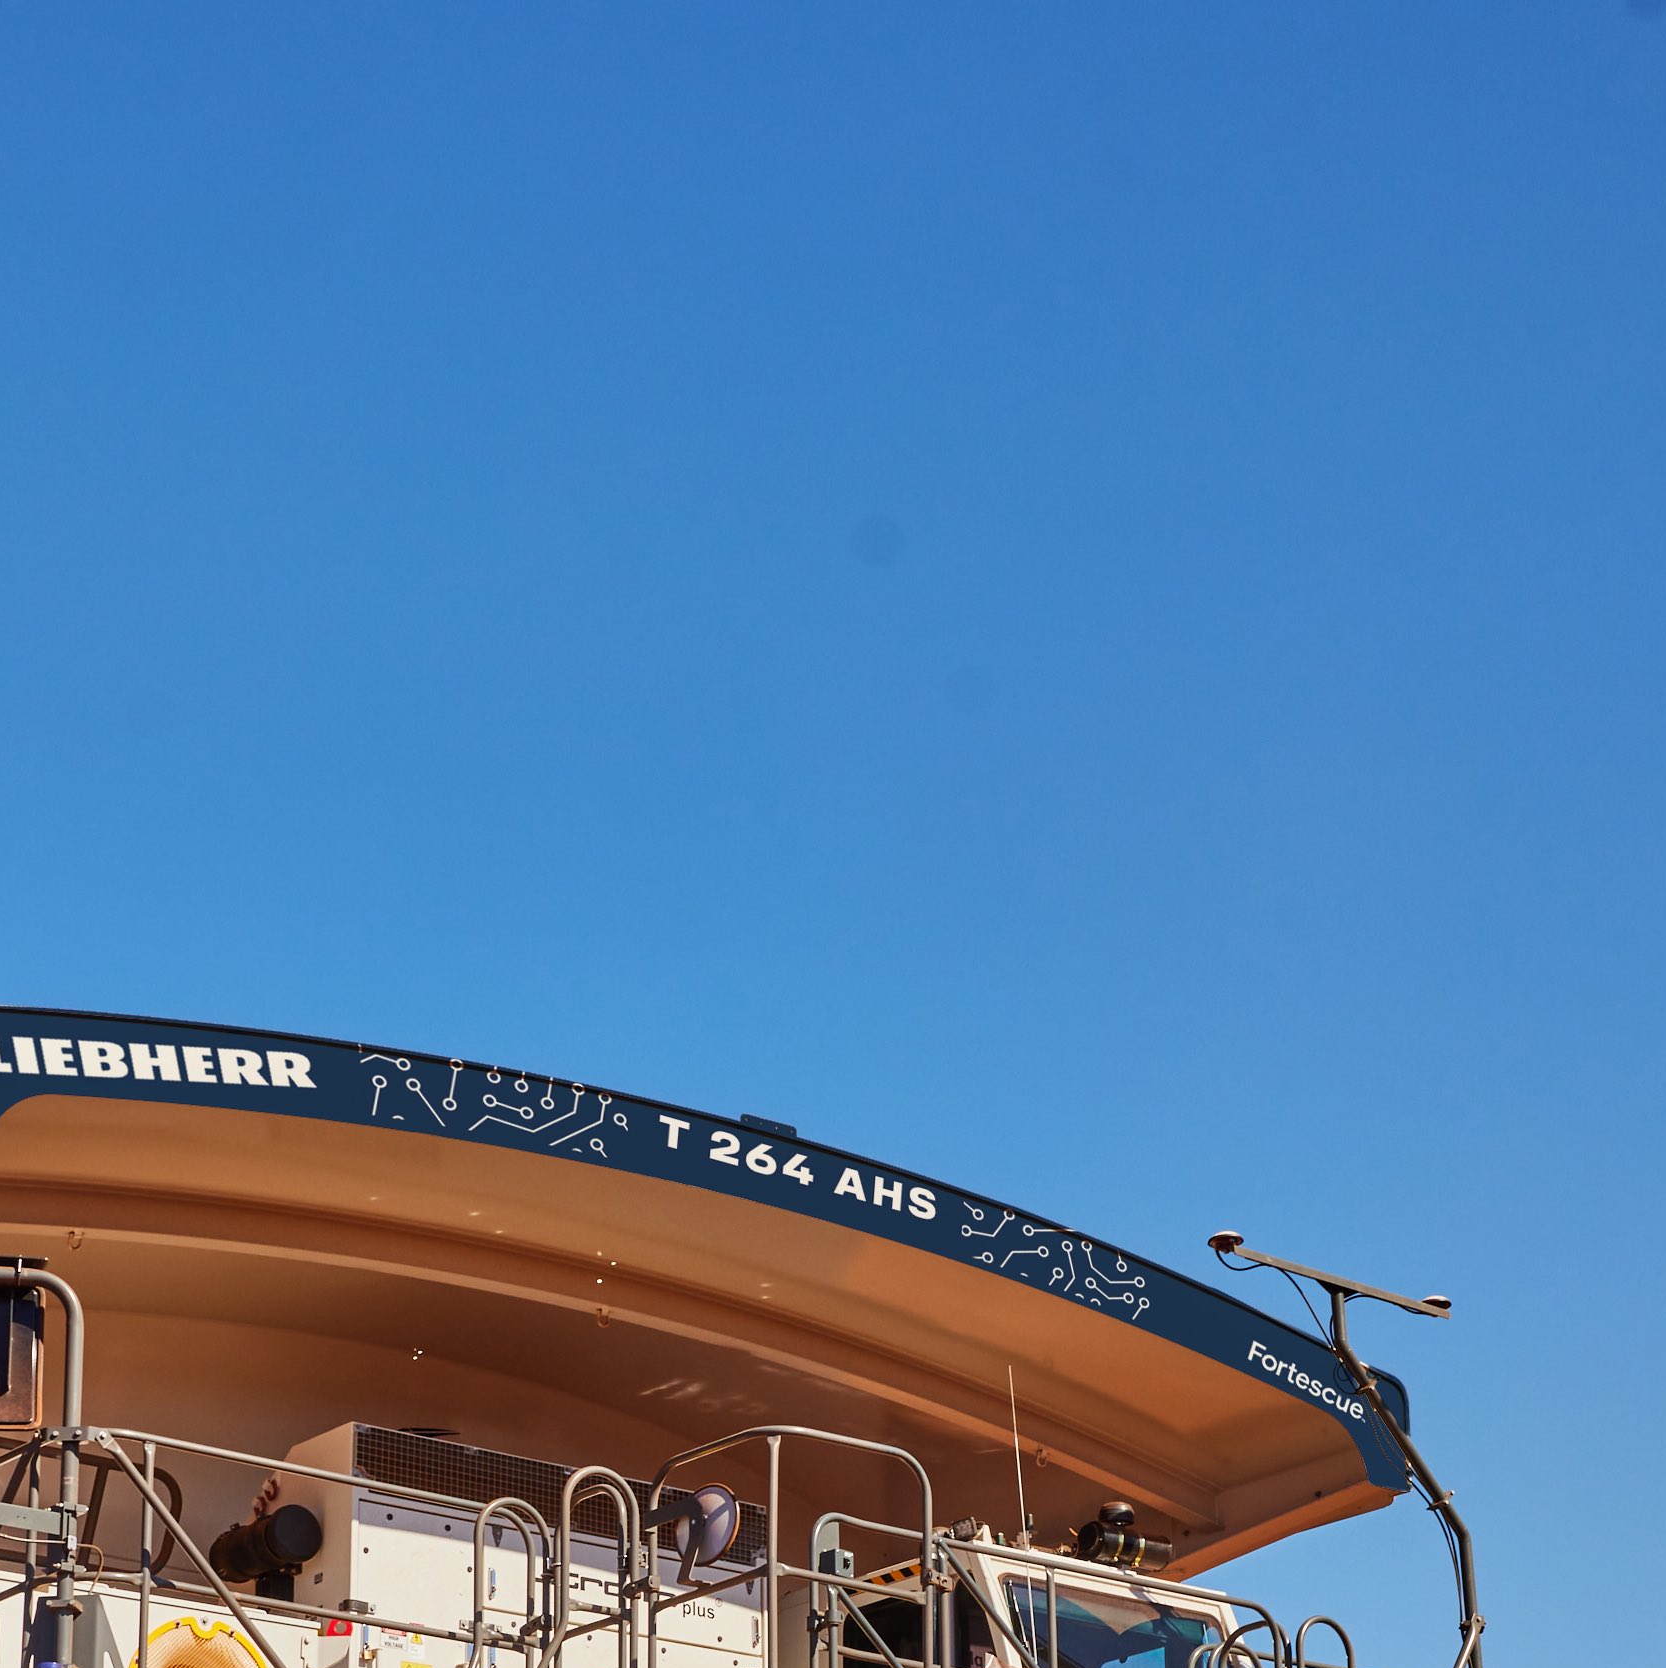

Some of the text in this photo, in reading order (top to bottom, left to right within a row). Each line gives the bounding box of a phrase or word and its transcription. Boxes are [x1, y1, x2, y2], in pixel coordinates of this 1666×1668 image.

[658, 1114, 937, 1221] T 264 AHS
[1247, 1340, 1364, 1420] Fortescue
